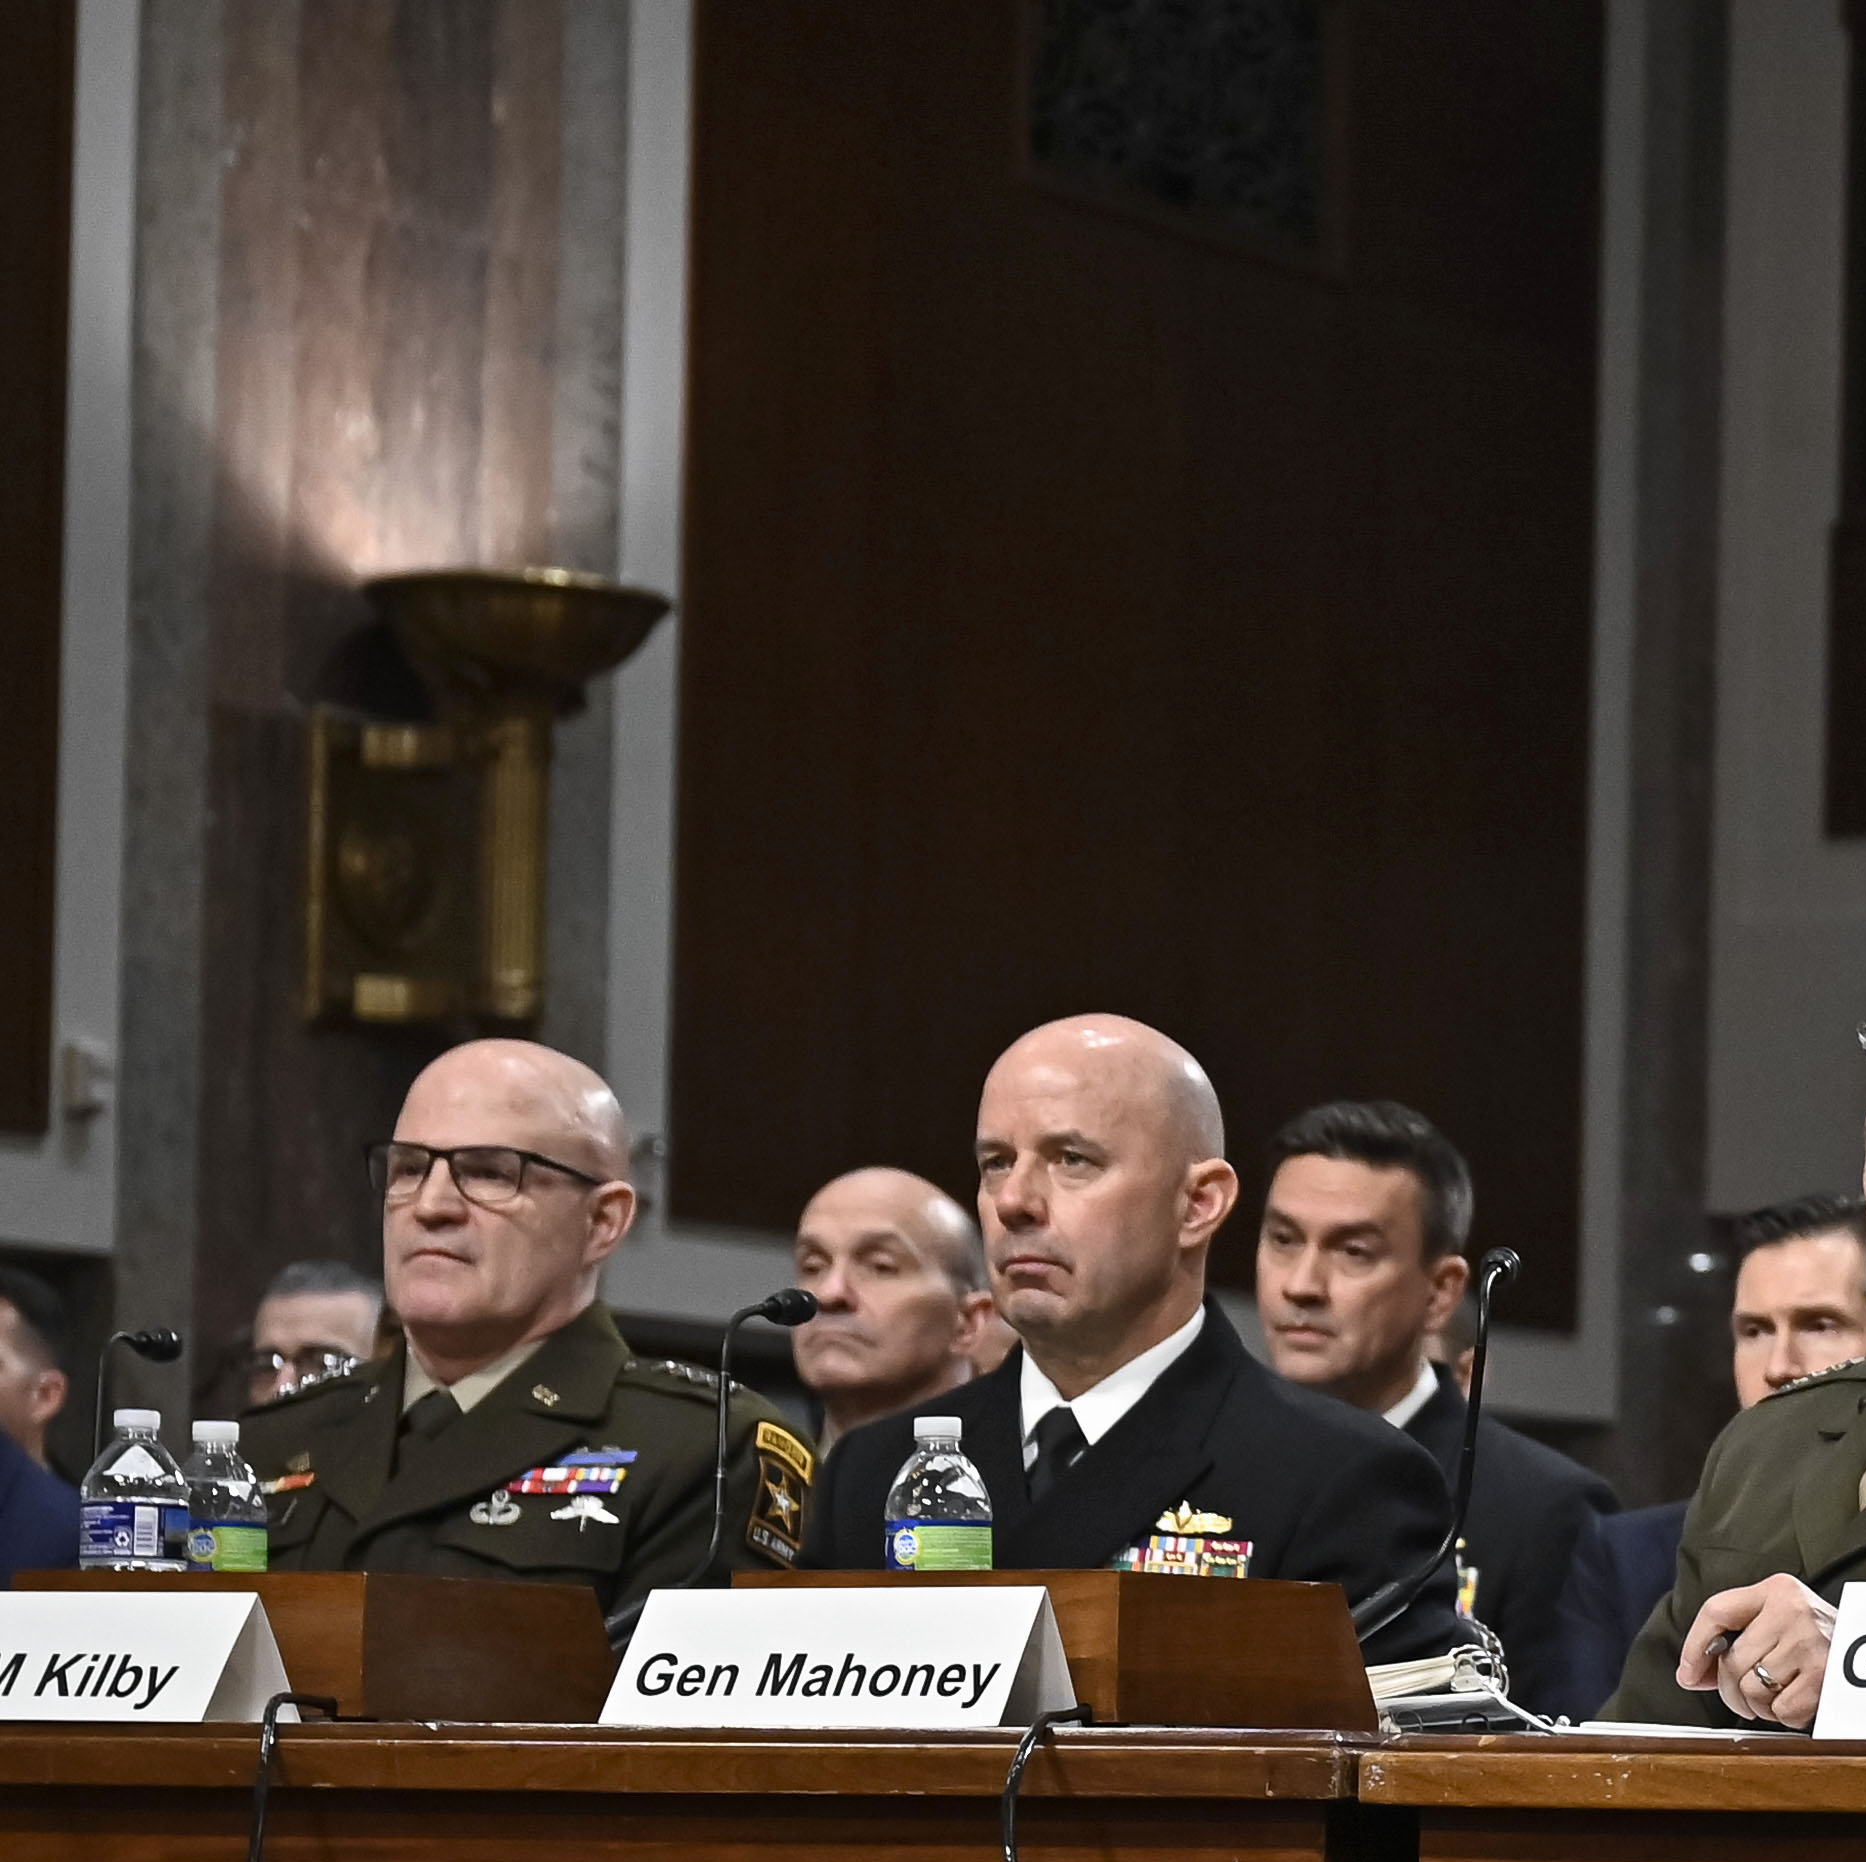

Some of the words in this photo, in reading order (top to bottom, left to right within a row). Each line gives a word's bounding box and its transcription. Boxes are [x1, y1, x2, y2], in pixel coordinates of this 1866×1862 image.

[33, 1653, 181, 1710] Kilby
[636, 1652, 740, 1697] Gen
[755, 1652, 1001, 1709] Mahoney
